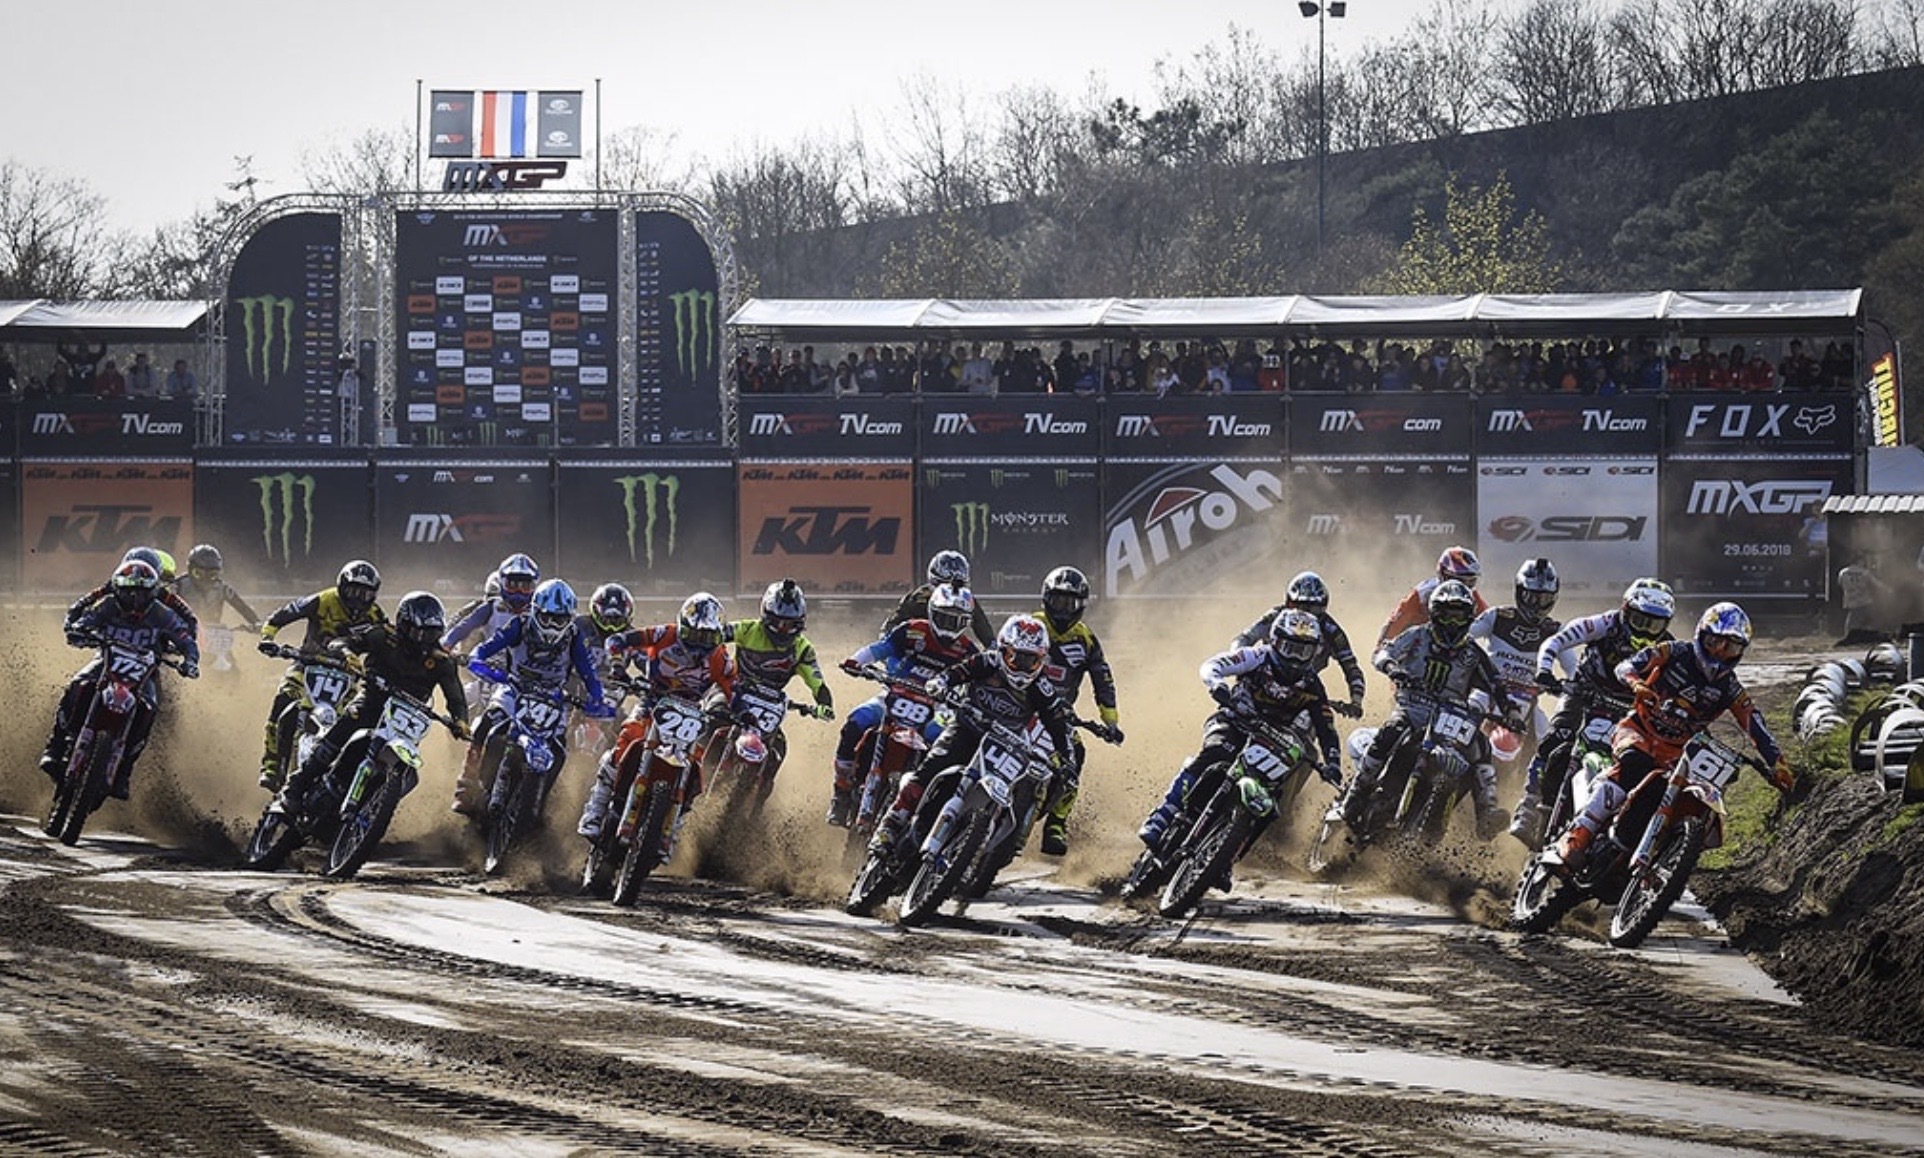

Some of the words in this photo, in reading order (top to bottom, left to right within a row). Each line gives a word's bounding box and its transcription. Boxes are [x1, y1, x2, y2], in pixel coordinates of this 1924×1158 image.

[443, 161, 567, 192] MXGP
[1403, 418, 1442, 431] com
[1685, 405, 1790, 437] FOX
[1687, 480, 1834, 519] MXGP
[36, 505, 184, 552] KTM
[752, 507, 902, 555] KTM
[991, 512, 1069, 526] MONSTER
[312, 675, 344, 703] 14
[890, 697, 930, 723] 98
[659, 711, 703, 743] 28
[984, 745, 1023, 780] 46
[1243, 743, 1290, 781] 911
[1688, 748, 1736, 789] 61
